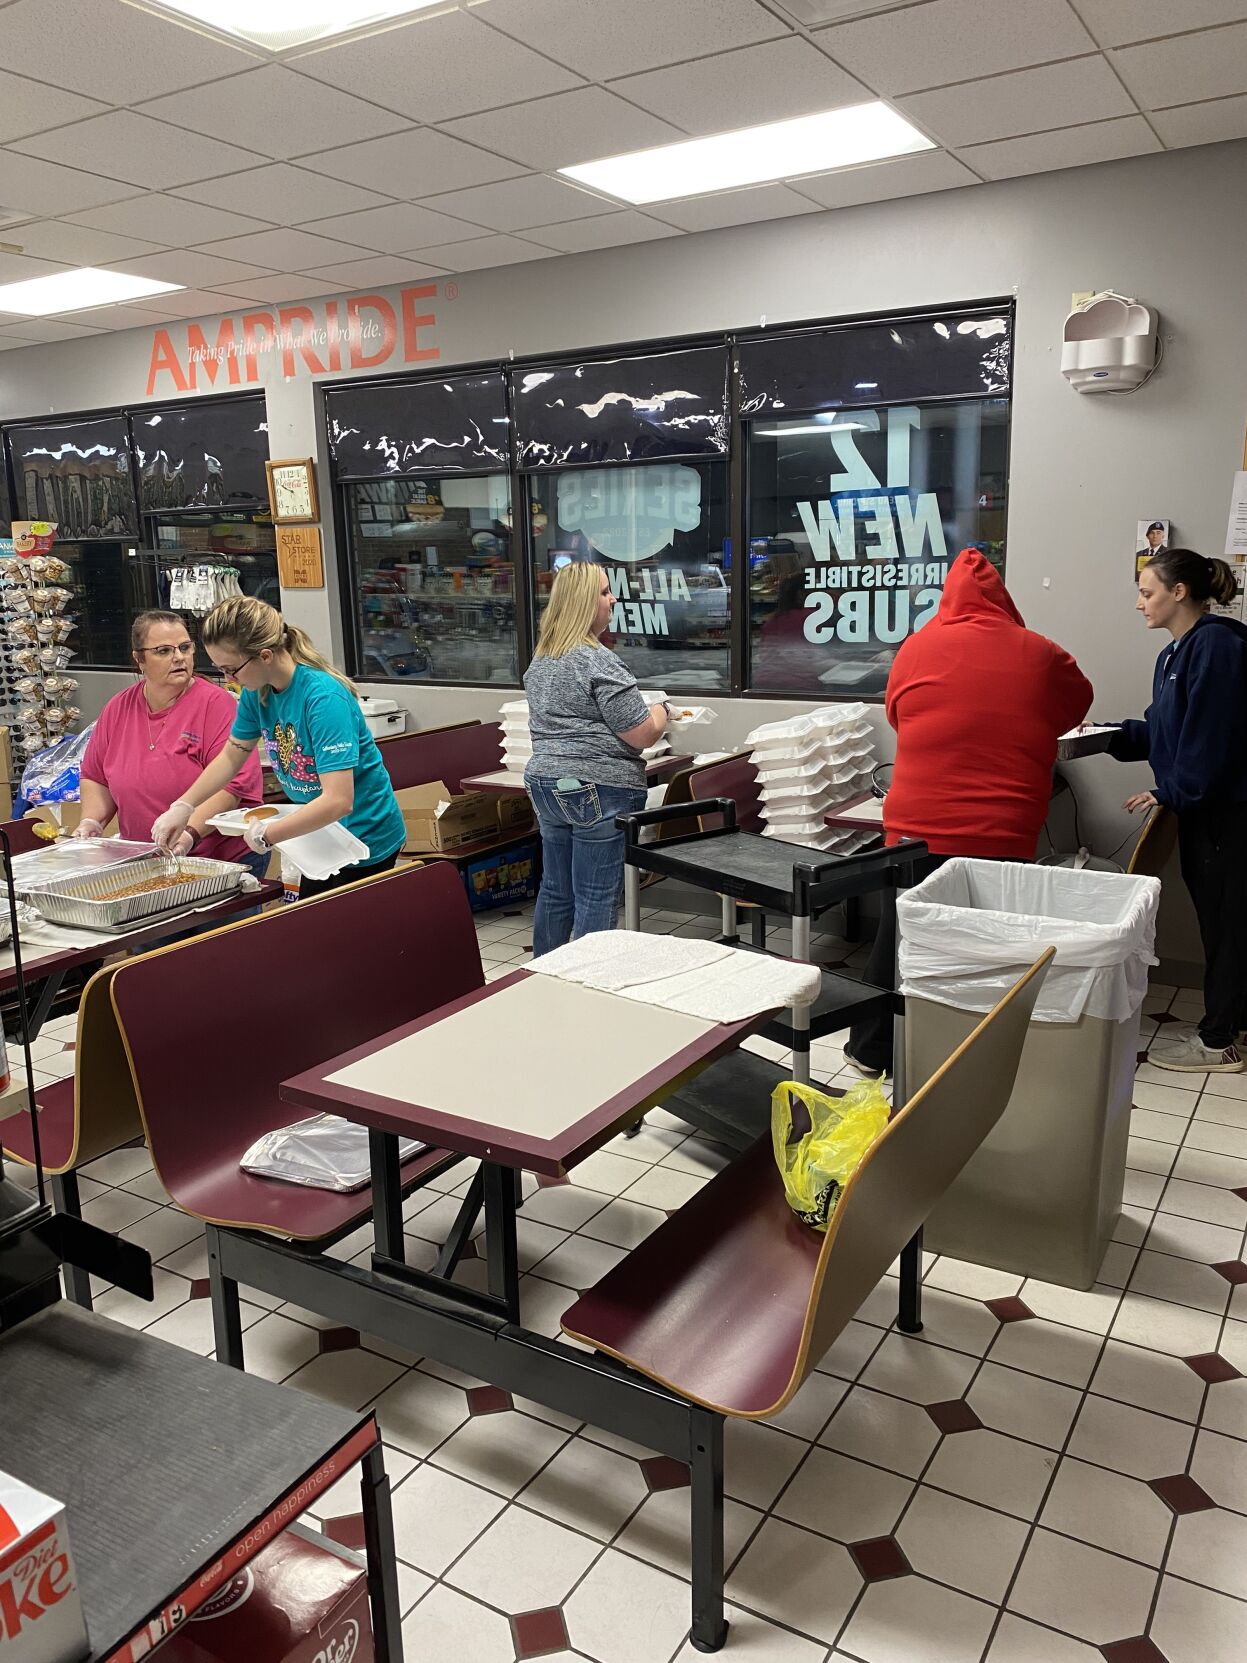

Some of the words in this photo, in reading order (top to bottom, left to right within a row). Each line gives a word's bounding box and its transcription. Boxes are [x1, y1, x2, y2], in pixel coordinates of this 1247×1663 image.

[146, 284, 441, 396] AMPRIDE
[187, 344, 224, 365] Taking
[227, 338, 258, 359] Pride
[258, 336, 274, 353] in
[275, 330, 308, 352] What
[310, 328, 329, 346] We
[979, 495, 987, 506] 4
[281, 534, 302, 545] STAR
[292, 546, 316, 554] STORE
[235, 1522, 271, 1558] open
[273, 1460, 336, 1525] happiness
[13, 1538, 58, 1582] Diet
[205, 1589, 240, 1612] FLAVORS
